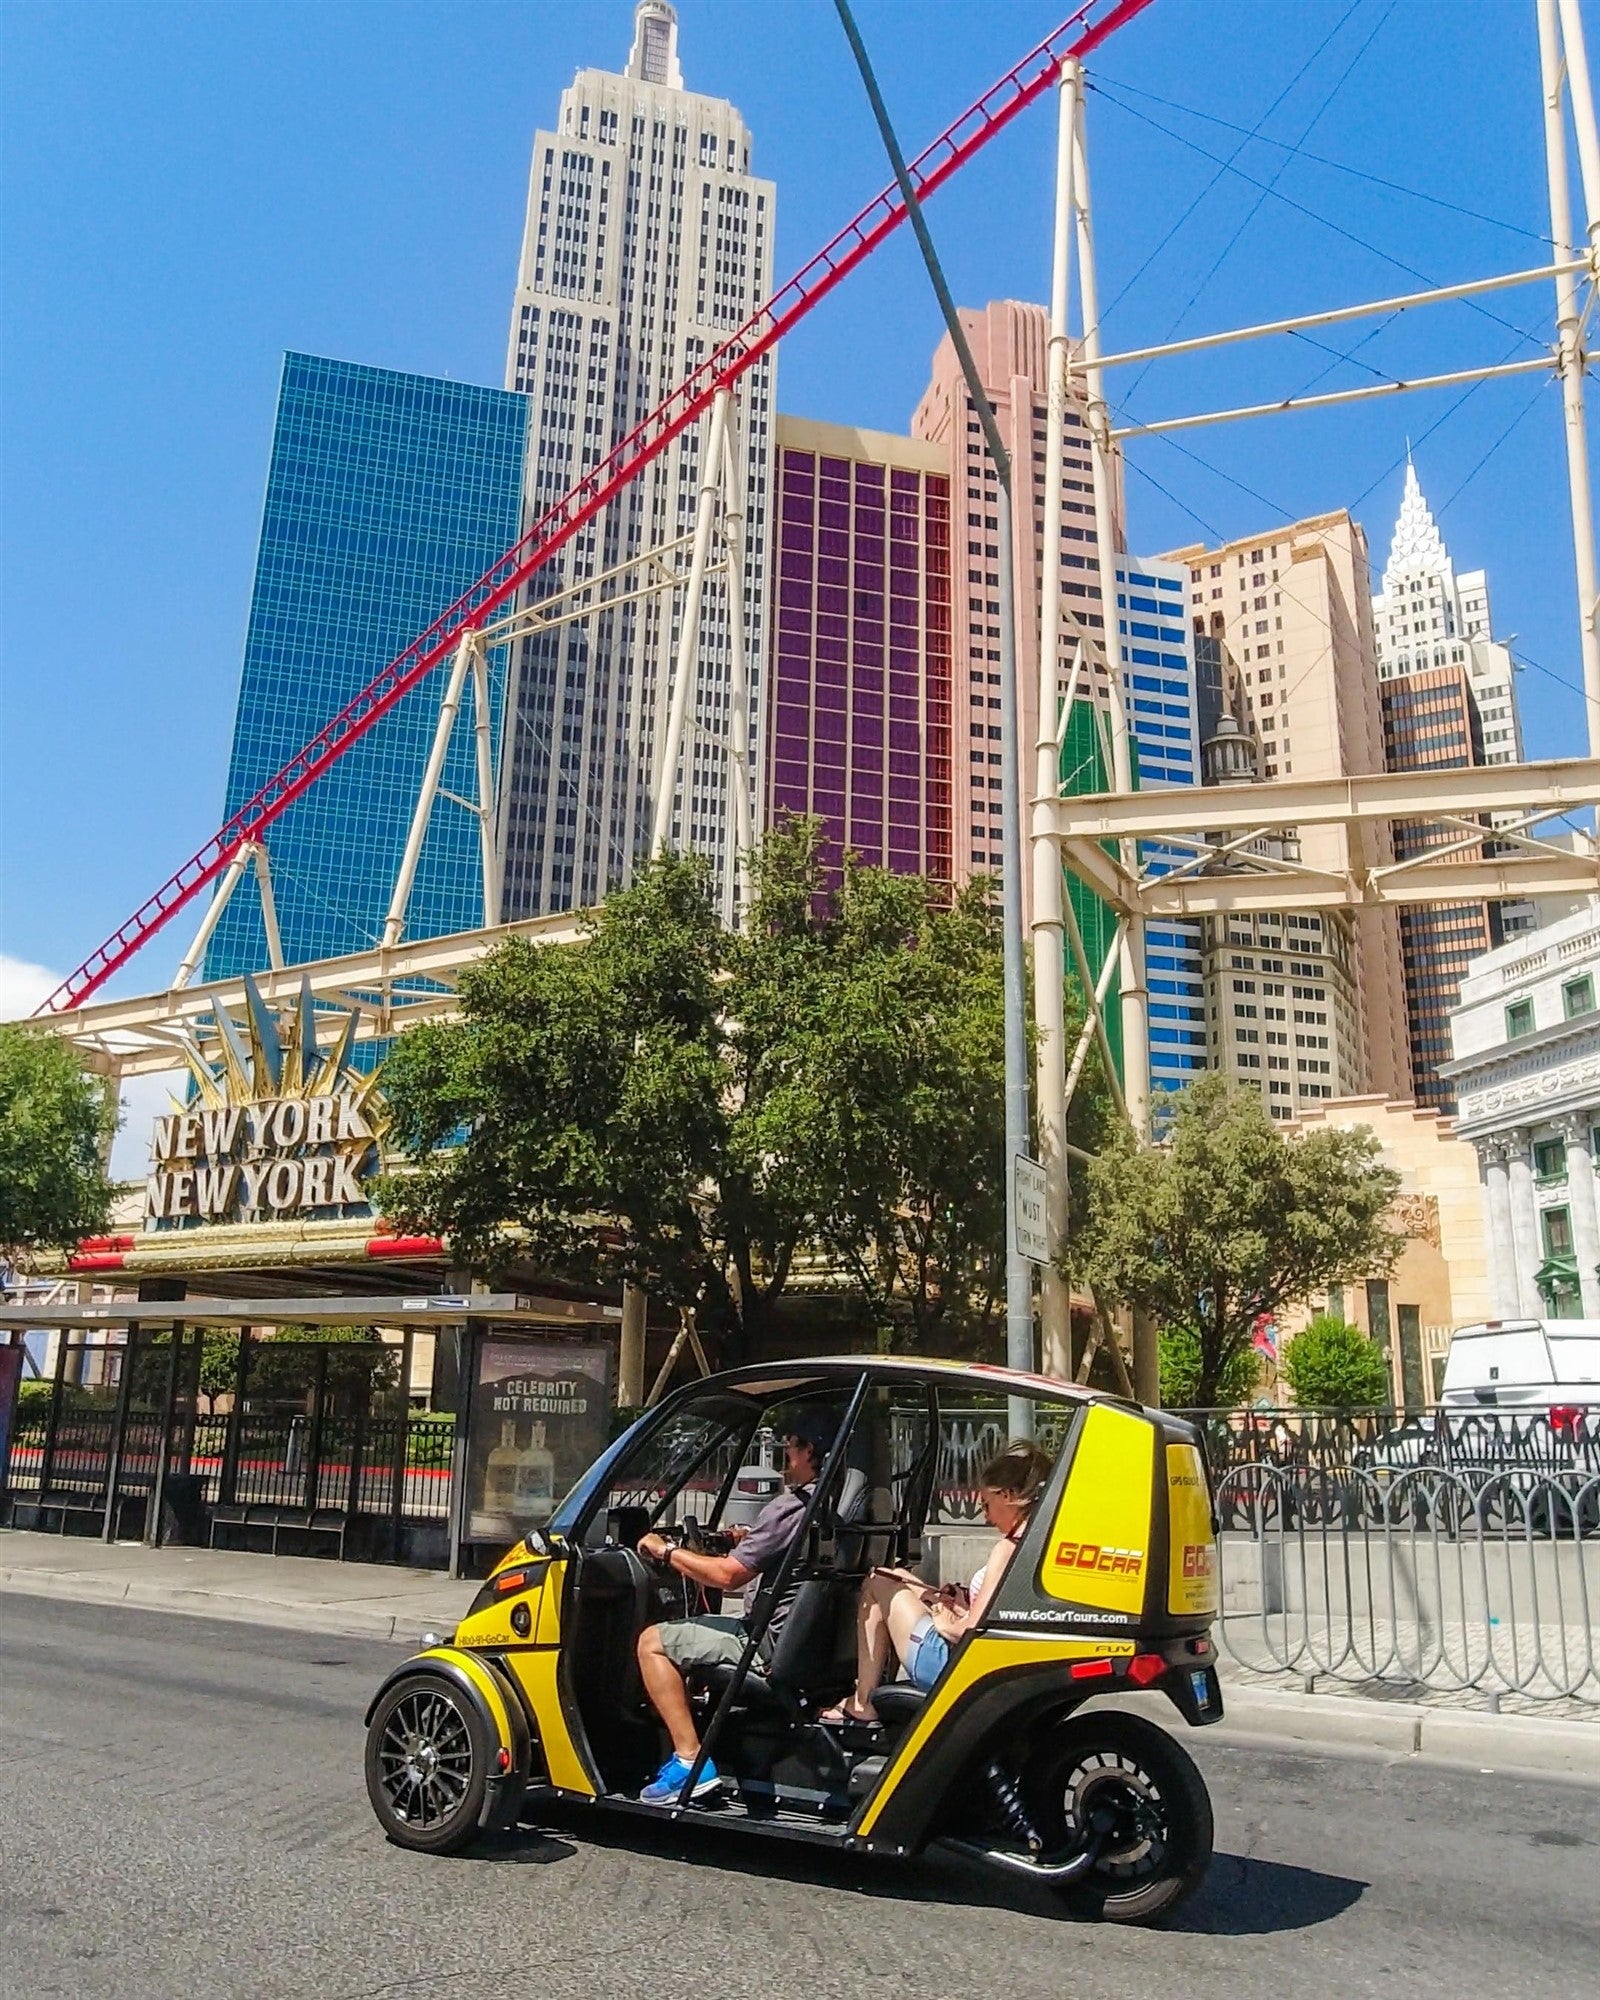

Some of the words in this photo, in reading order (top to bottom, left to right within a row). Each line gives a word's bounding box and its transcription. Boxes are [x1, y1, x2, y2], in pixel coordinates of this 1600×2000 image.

[151, 1107, 241, 1161] NEW
[247, 1092, 372, 1149] YORK
[144, 1165, 235, 1219] NEW
[241, 1154, 368, 1211] YORK
[1022, 1198, 1041, 1222] MUST
[507, 1380, 578, 1397] CELEBRITY
[493, 1396, 520, 1411] NOT
[523, 1397, 588, 1415] REQUIRED
[998, 1610, 1128, 1624] www.GoCarTours.com
[1095, 1645, 1132, 1653] FUV
